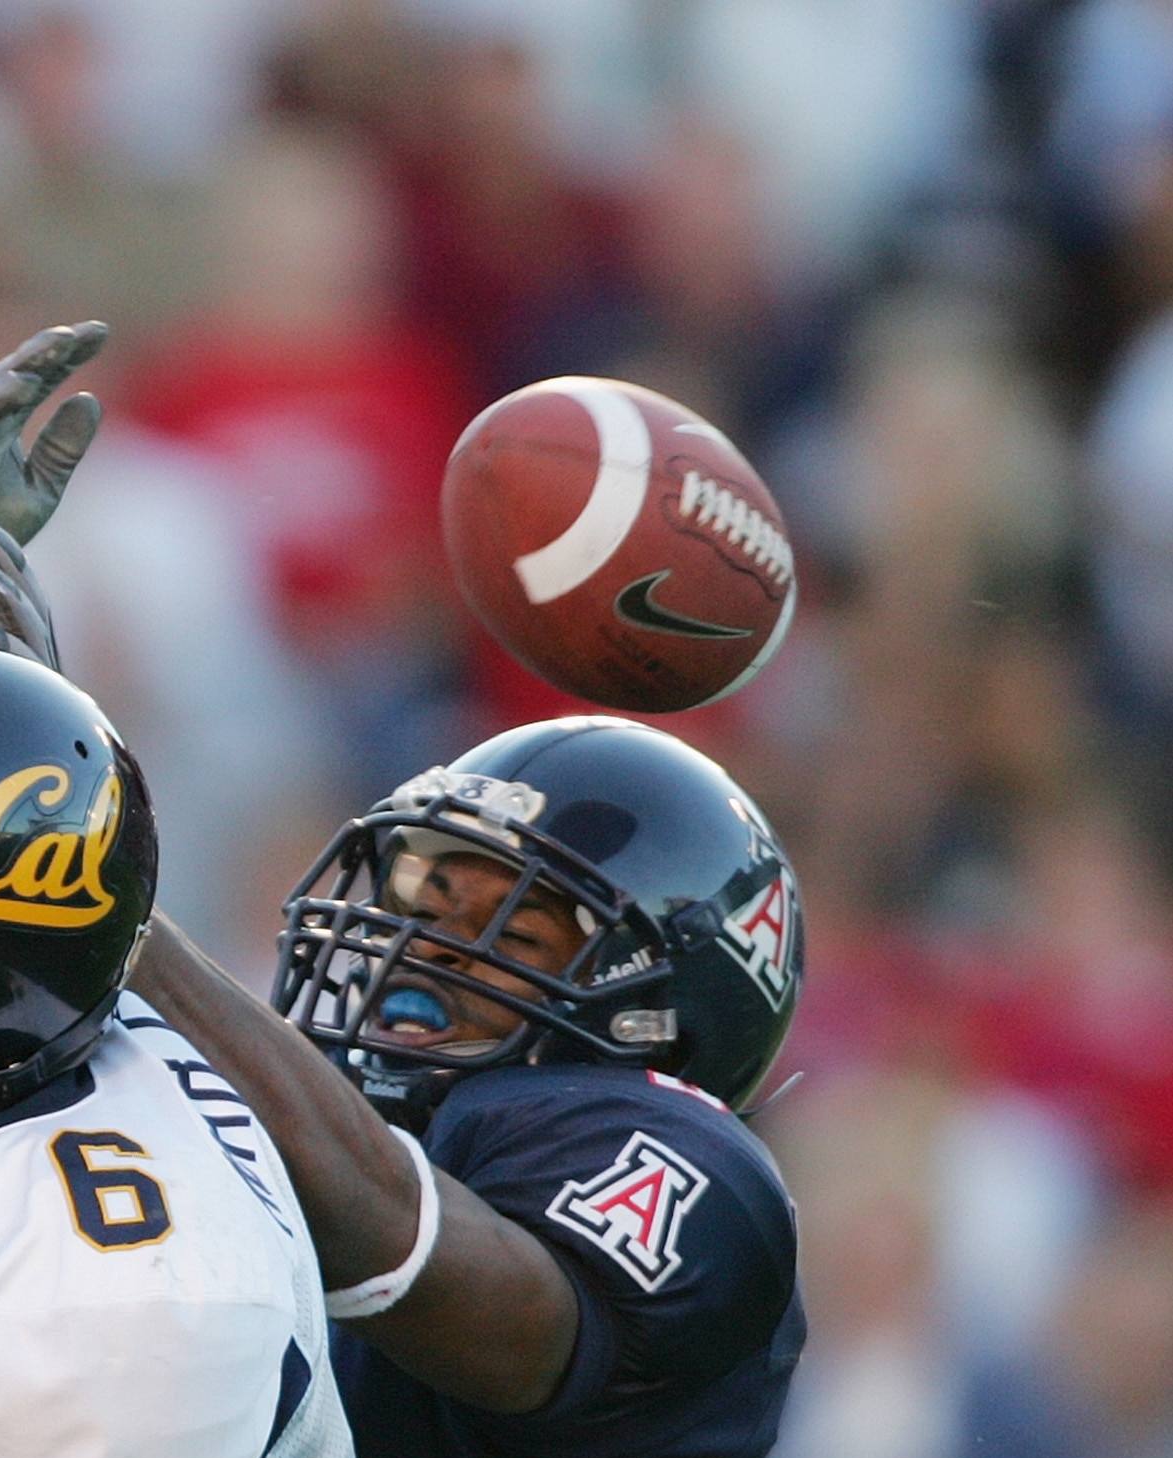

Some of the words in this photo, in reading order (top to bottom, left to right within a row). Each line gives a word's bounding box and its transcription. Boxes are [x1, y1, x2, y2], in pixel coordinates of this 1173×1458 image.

[715, 822, 796, 1014] A
[45, 1129, 174, 1253] 6
[544, 1130, 709, 1293] A
